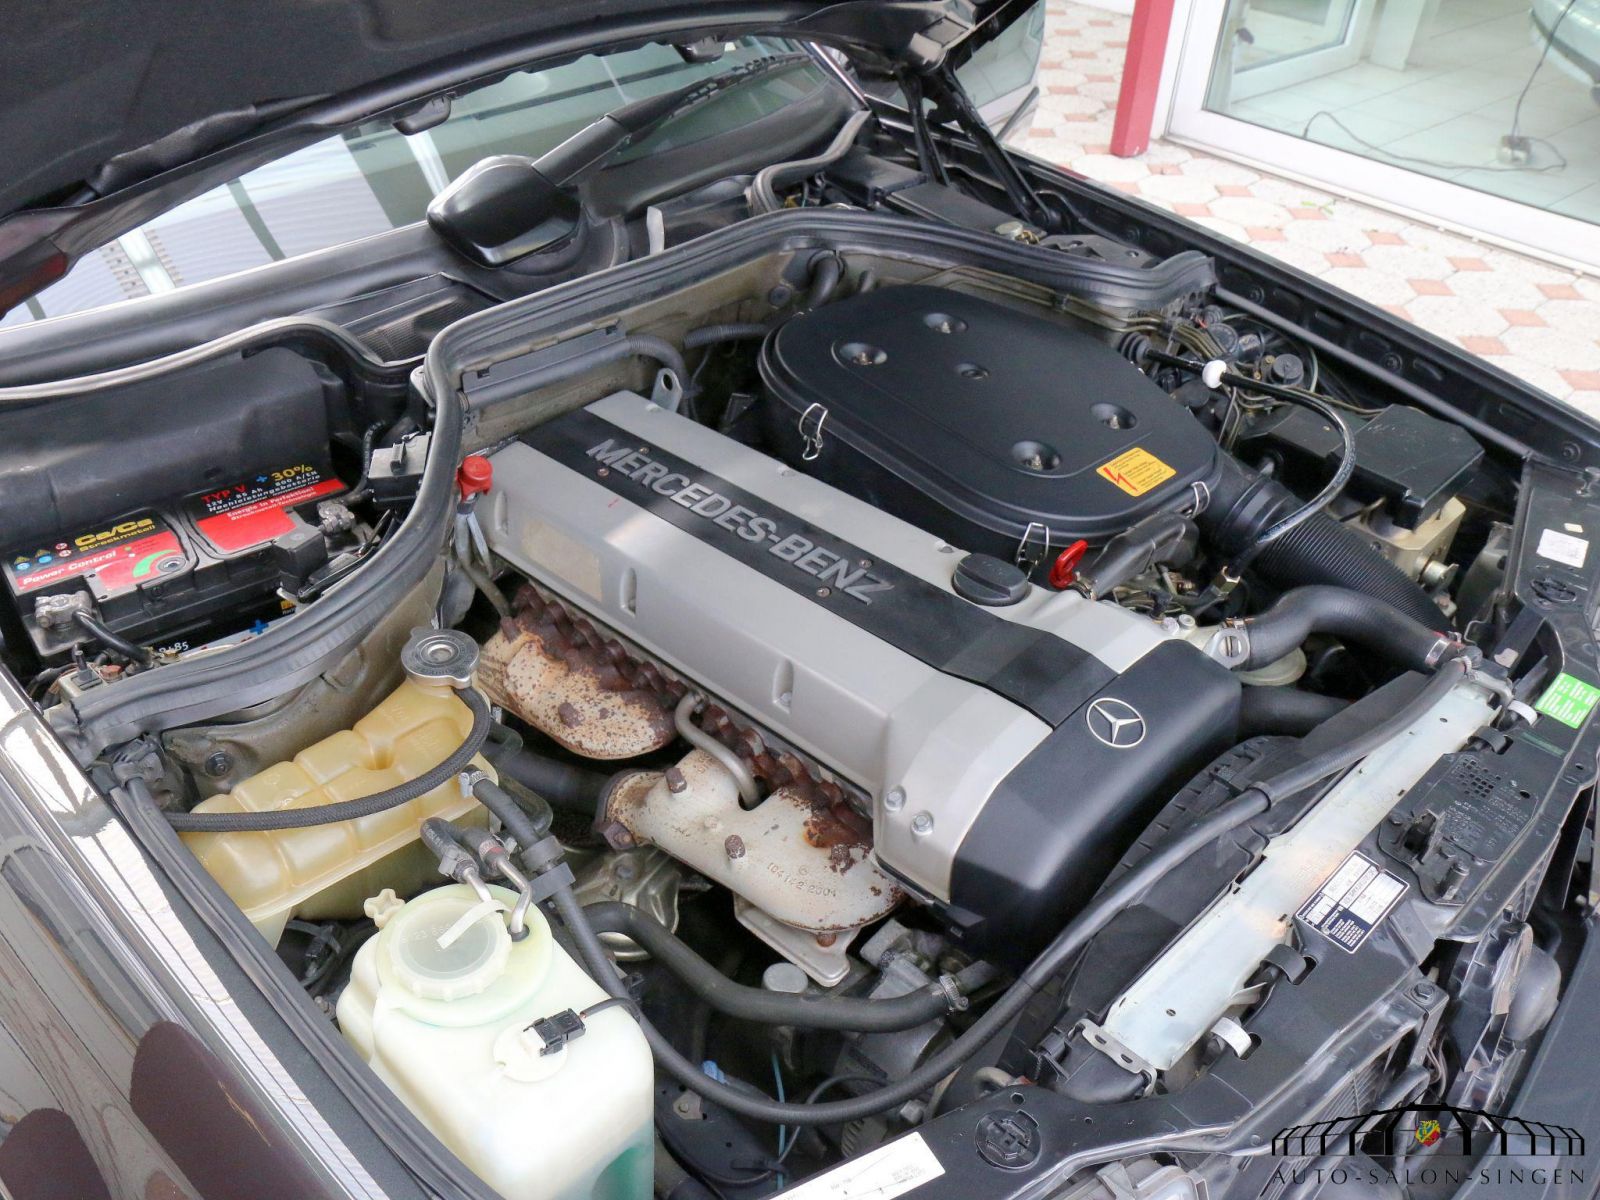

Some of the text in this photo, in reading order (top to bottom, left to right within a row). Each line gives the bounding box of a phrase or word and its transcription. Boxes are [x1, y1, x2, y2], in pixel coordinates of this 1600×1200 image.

[271, 463, 313, 482] 30%
[202, 489, 230, 503] TYP
[74, 517, 154, 548] Ca/Ca
[585, 438, 895, 606] MERCEDES-BENZ
[78, 525, 156, 552] Streckmetall
[22, 550, 117, 585] Power Control
